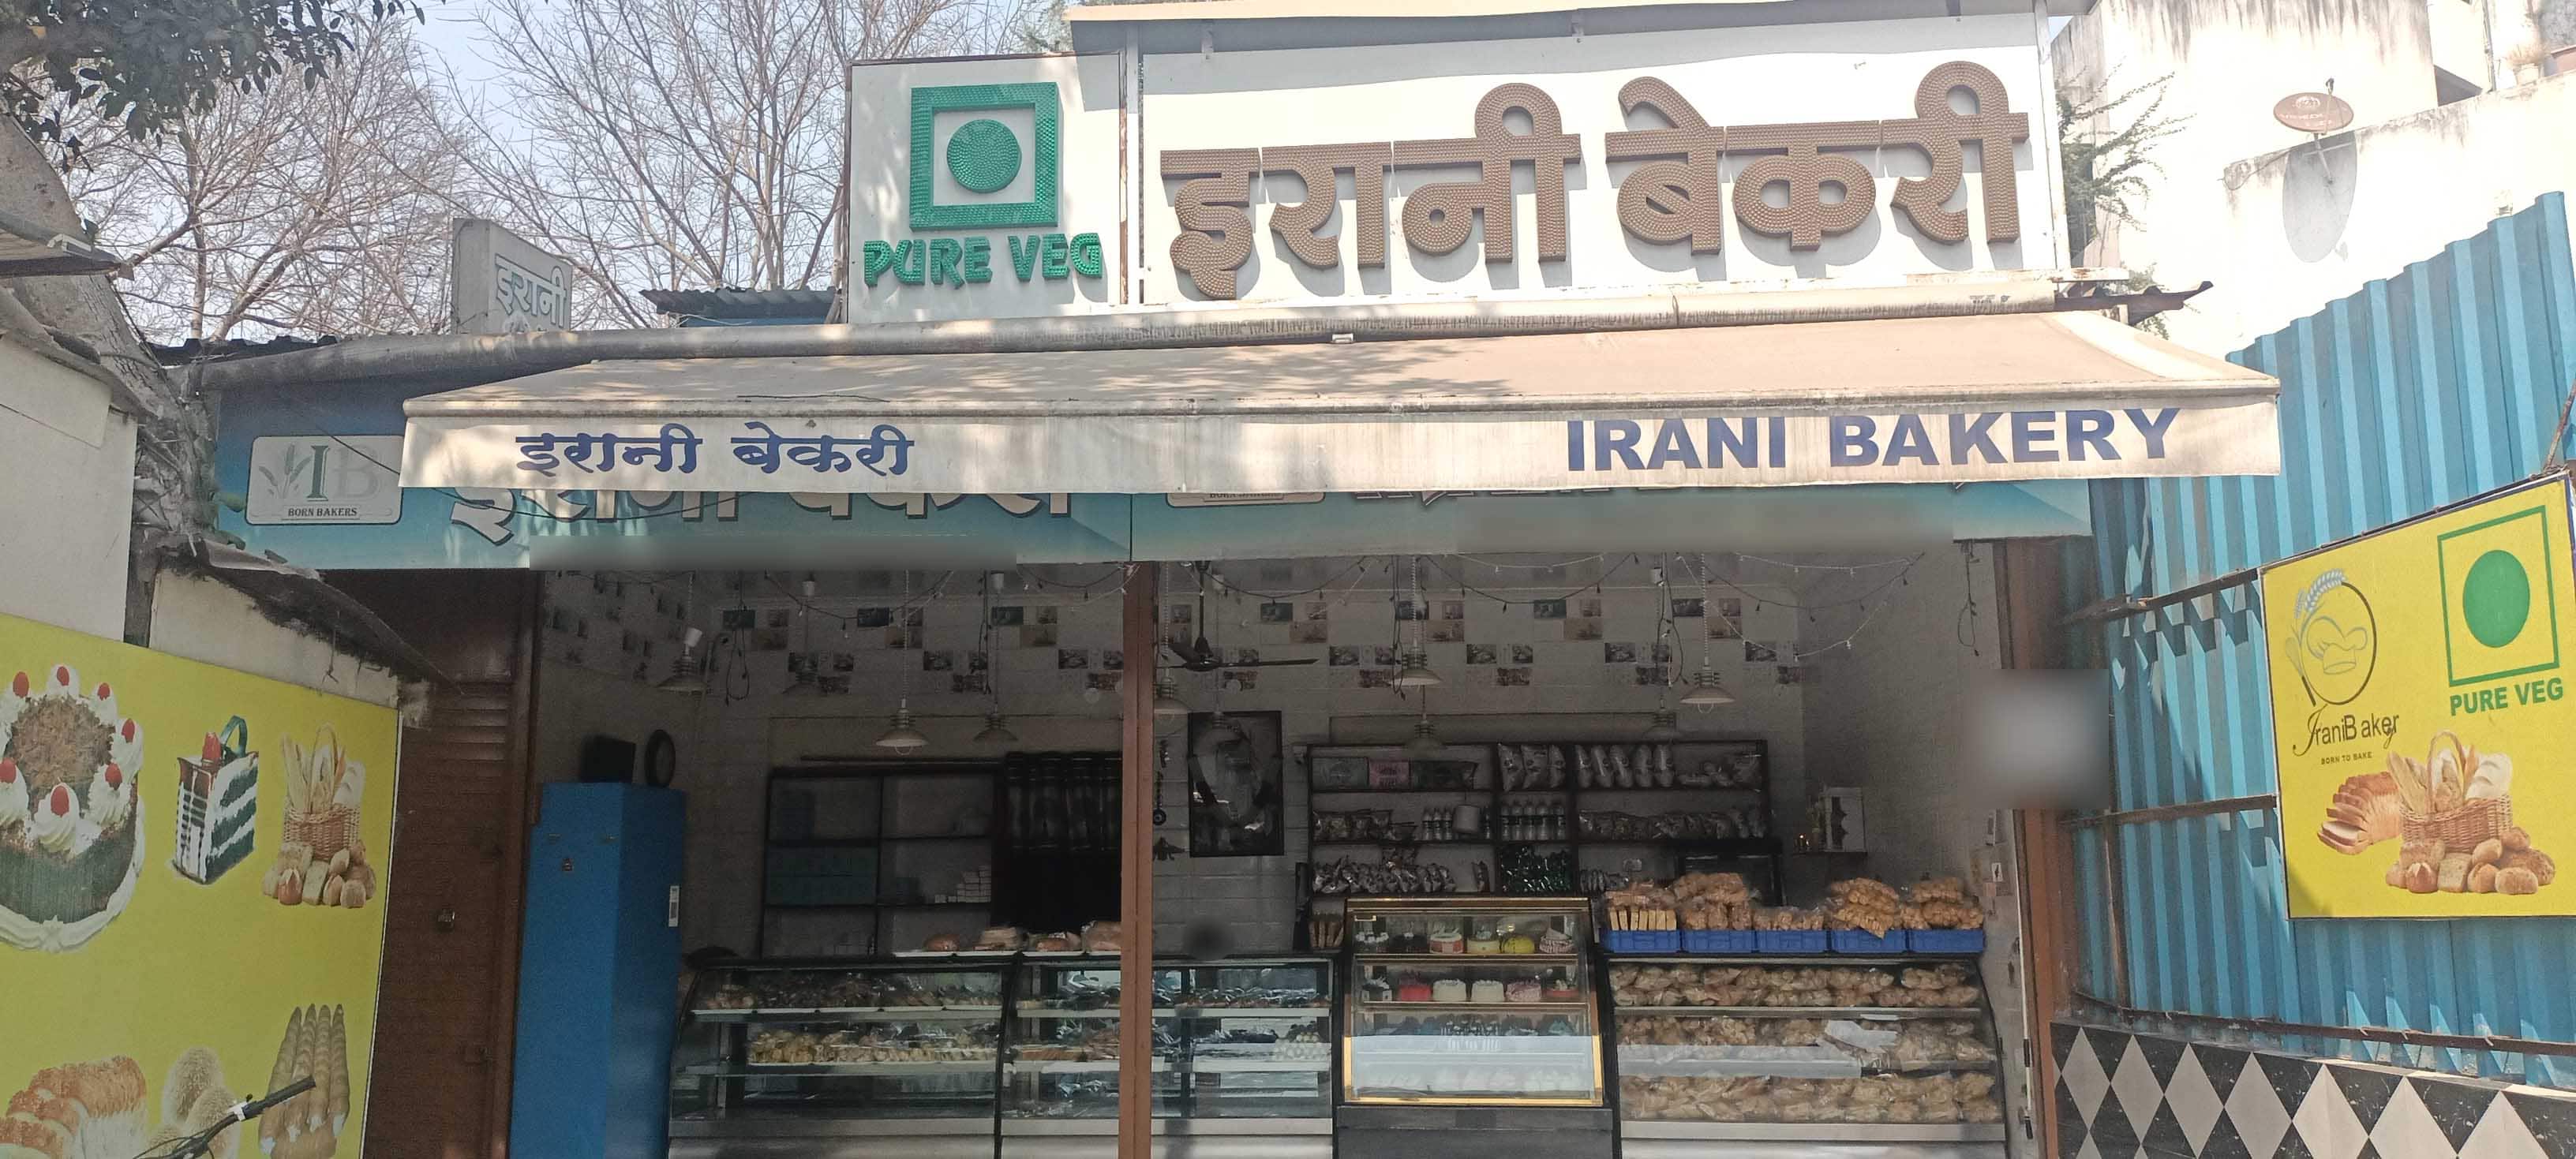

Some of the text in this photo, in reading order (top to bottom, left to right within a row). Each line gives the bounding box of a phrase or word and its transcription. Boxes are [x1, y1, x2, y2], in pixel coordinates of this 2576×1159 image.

[1160, 60, 2030, 301] इरानी बेकरी
[863, 232, 1103, 289] PURE VEG
[494, 252, 567, 329] इरानी
[515, 421, 915, 477] इरानी बेकरी
[1567, 408, 2181, 471] IRANI BAKERY
[288, 507, 358, 518] BORN BAKERS
[2450, 677, 2564, 716] PURE VEG
[2321, 755, 2340, 765] BORN
[2353, 751, 2373, 761] BAKE
